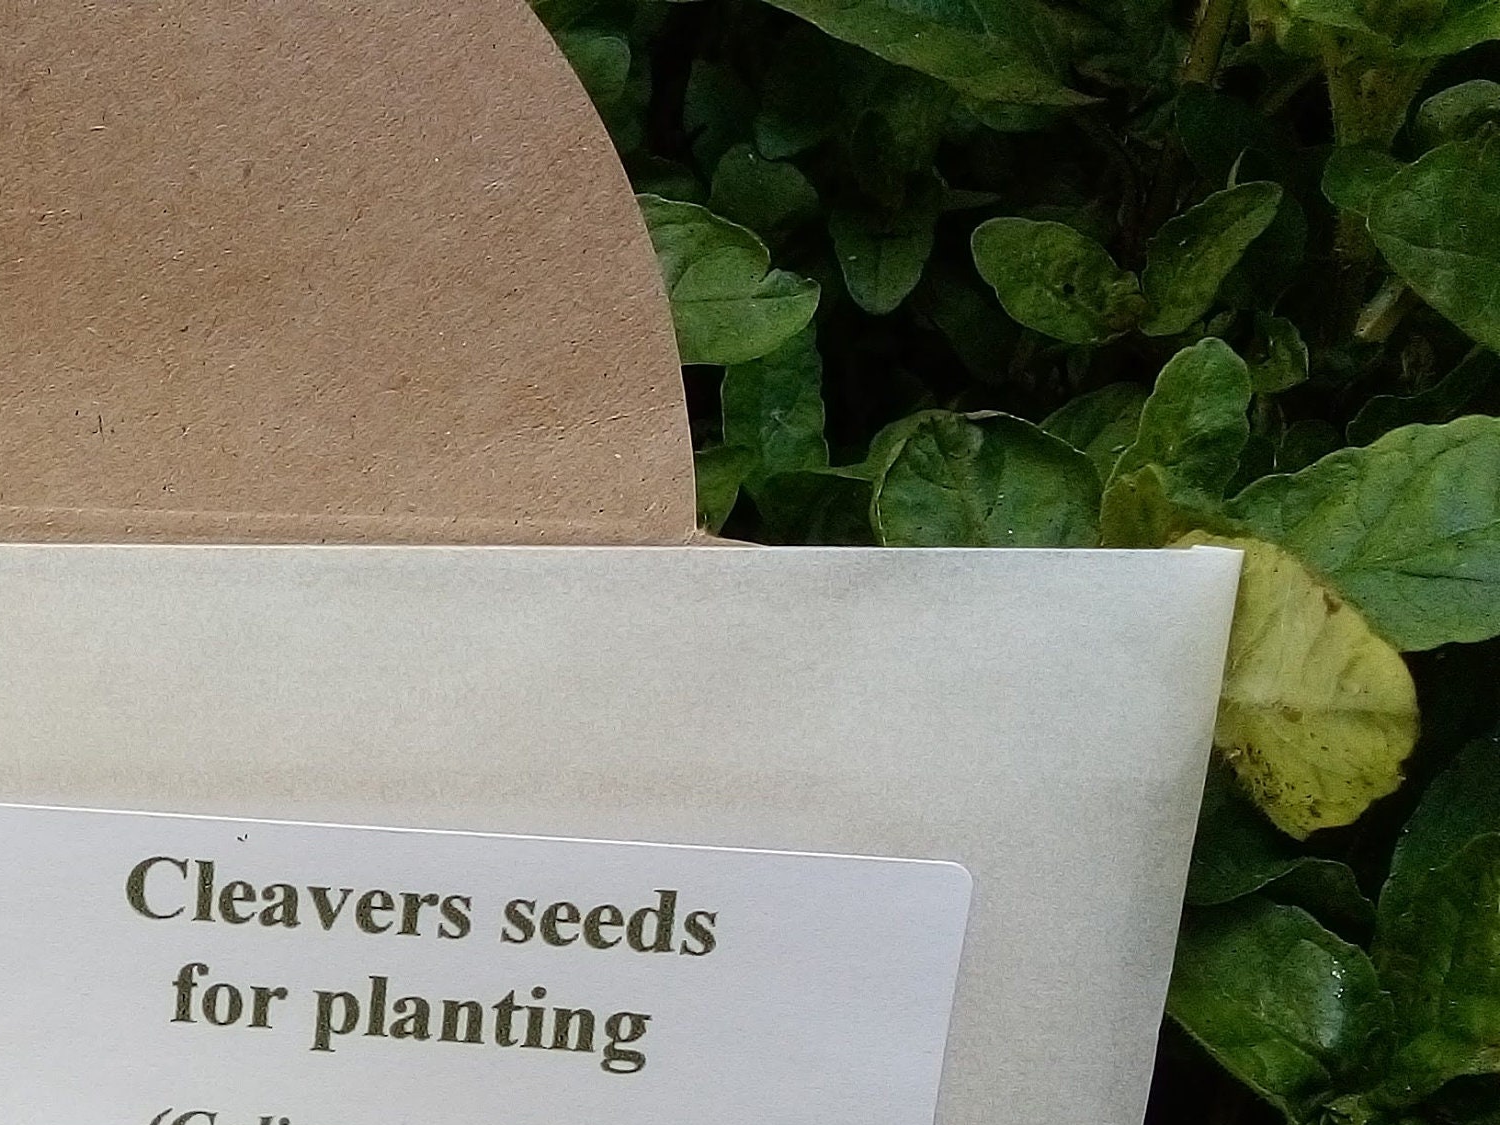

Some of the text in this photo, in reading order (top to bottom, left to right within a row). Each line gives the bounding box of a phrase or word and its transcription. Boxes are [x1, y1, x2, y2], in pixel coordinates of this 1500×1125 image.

[125, 855, 719, 957] Cleavers seeds
[171, 963, 653, 1075] for planting
